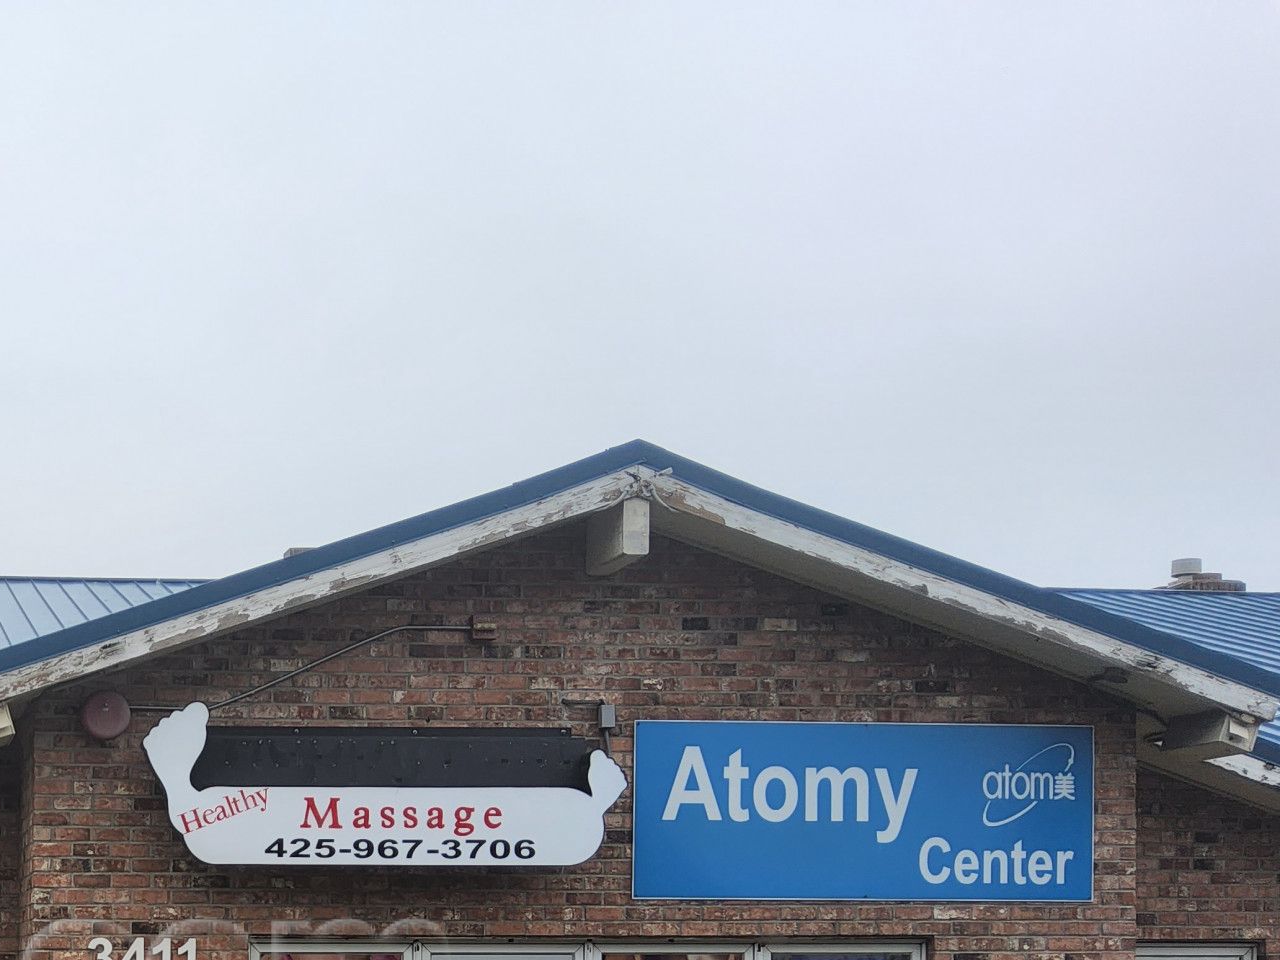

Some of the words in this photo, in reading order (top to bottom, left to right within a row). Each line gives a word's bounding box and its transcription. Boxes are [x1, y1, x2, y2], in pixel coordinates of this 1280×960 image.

[177, 788, 270, 835] Healthy
[300, 797, 504, 837] Massage
[661, 745, 918, 844] Atomy
[264, 837, 537, 860] 425-967-3706
[919, 836, 1075, 886] Center
